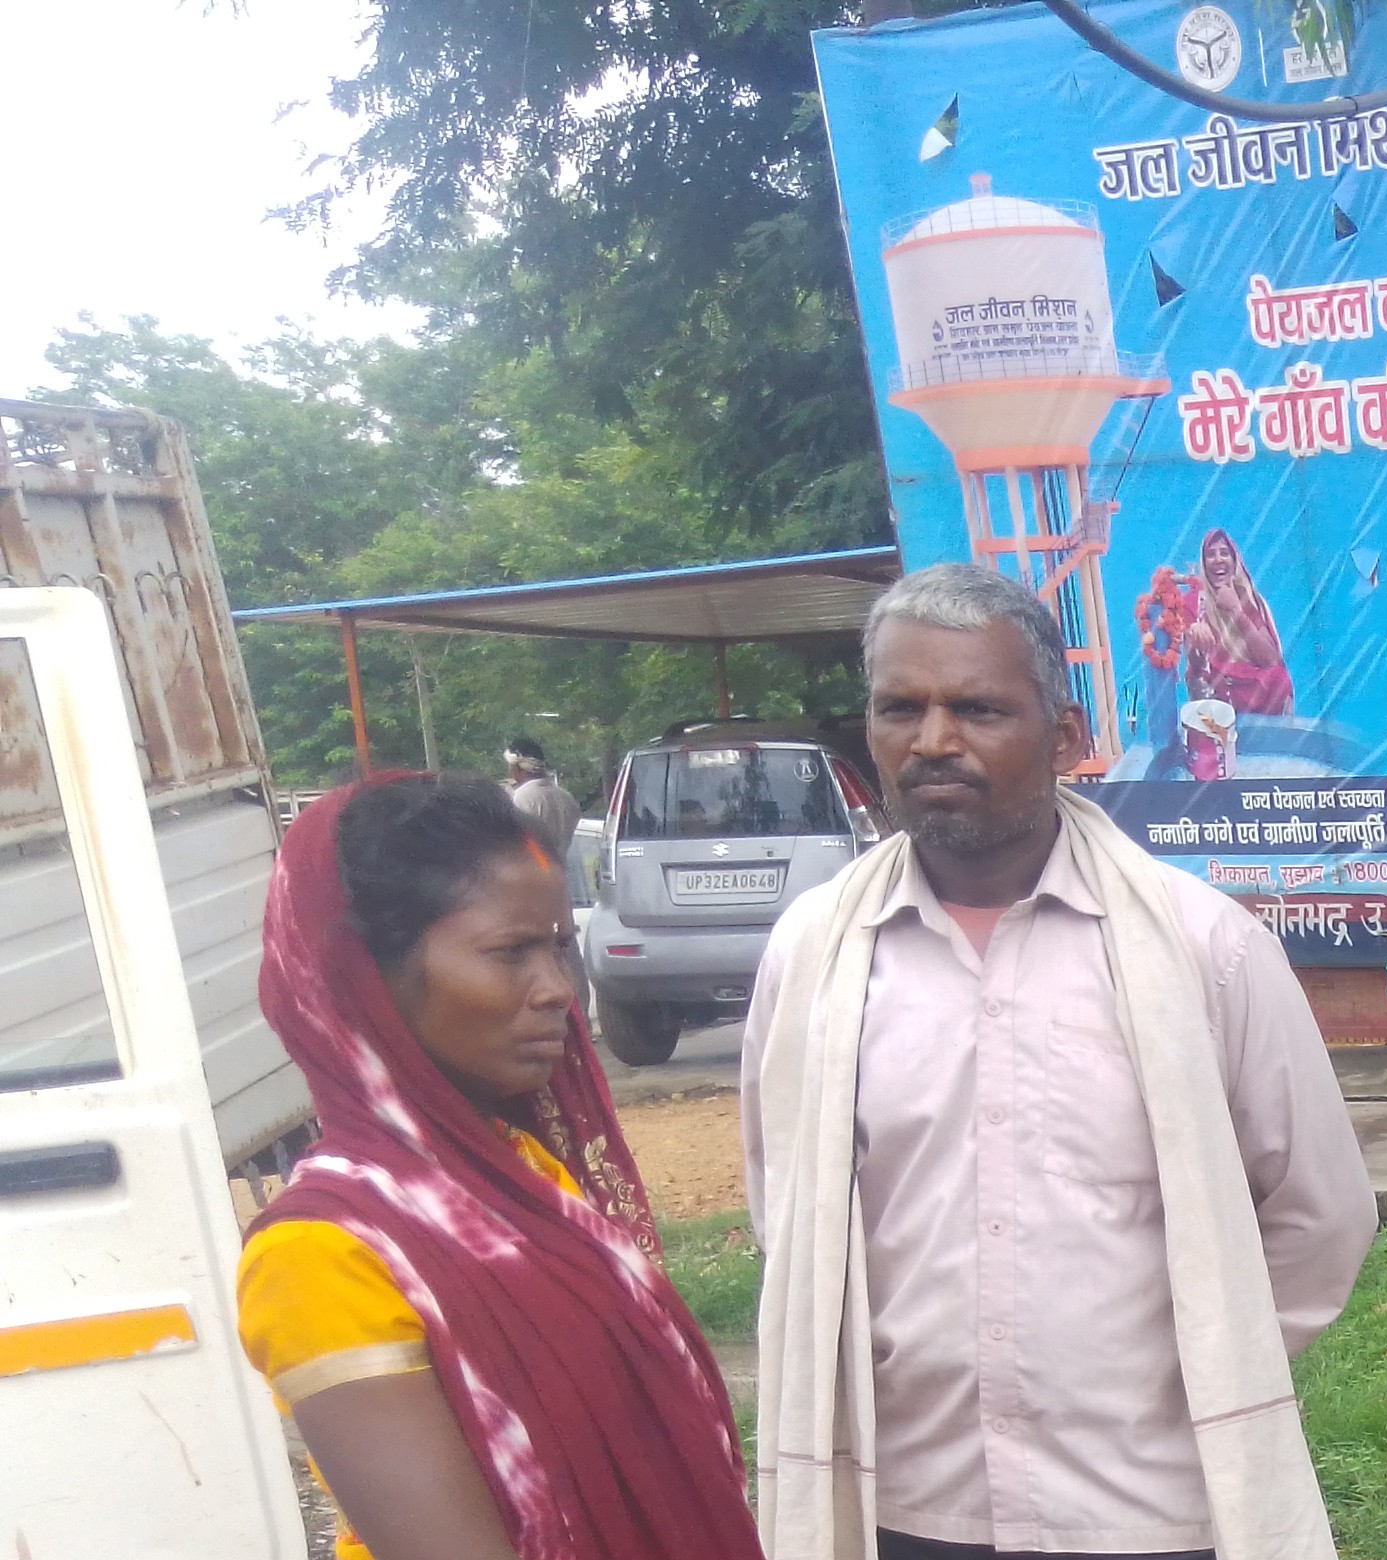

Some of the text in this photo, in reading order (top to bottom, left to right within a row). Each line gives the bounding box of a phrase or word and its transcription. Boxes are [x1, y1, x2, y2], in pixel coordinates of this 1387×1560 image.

[1095, 139, 1181, 199] जल
[1183, 112, 1311, 189] जीवन
[945, 295, 1076, 324] जल जीवन मिशन
[1250, 275, 1373, 346] पेयजल
[1179, 368, 1254, 463] मेरे
[1256, 362, 1351, 456] गाँव
[1241, 792, 1271, 810] राज्य
[1273, 786, 1315, 809] पेयजल
[1318, 788, 1336, 808] एवं
[1337, 790, 1385, 808] स्वच्छता
[1147, 817, 1199, 845] नमामि
[1202, 816, 1233, 844] गंगे
[1236, 819, 1259, 844] एवं
[1262, 815, 1317, 846] ग्रामीण
[1320, 813, 1386, 849] जलापूर्ति
